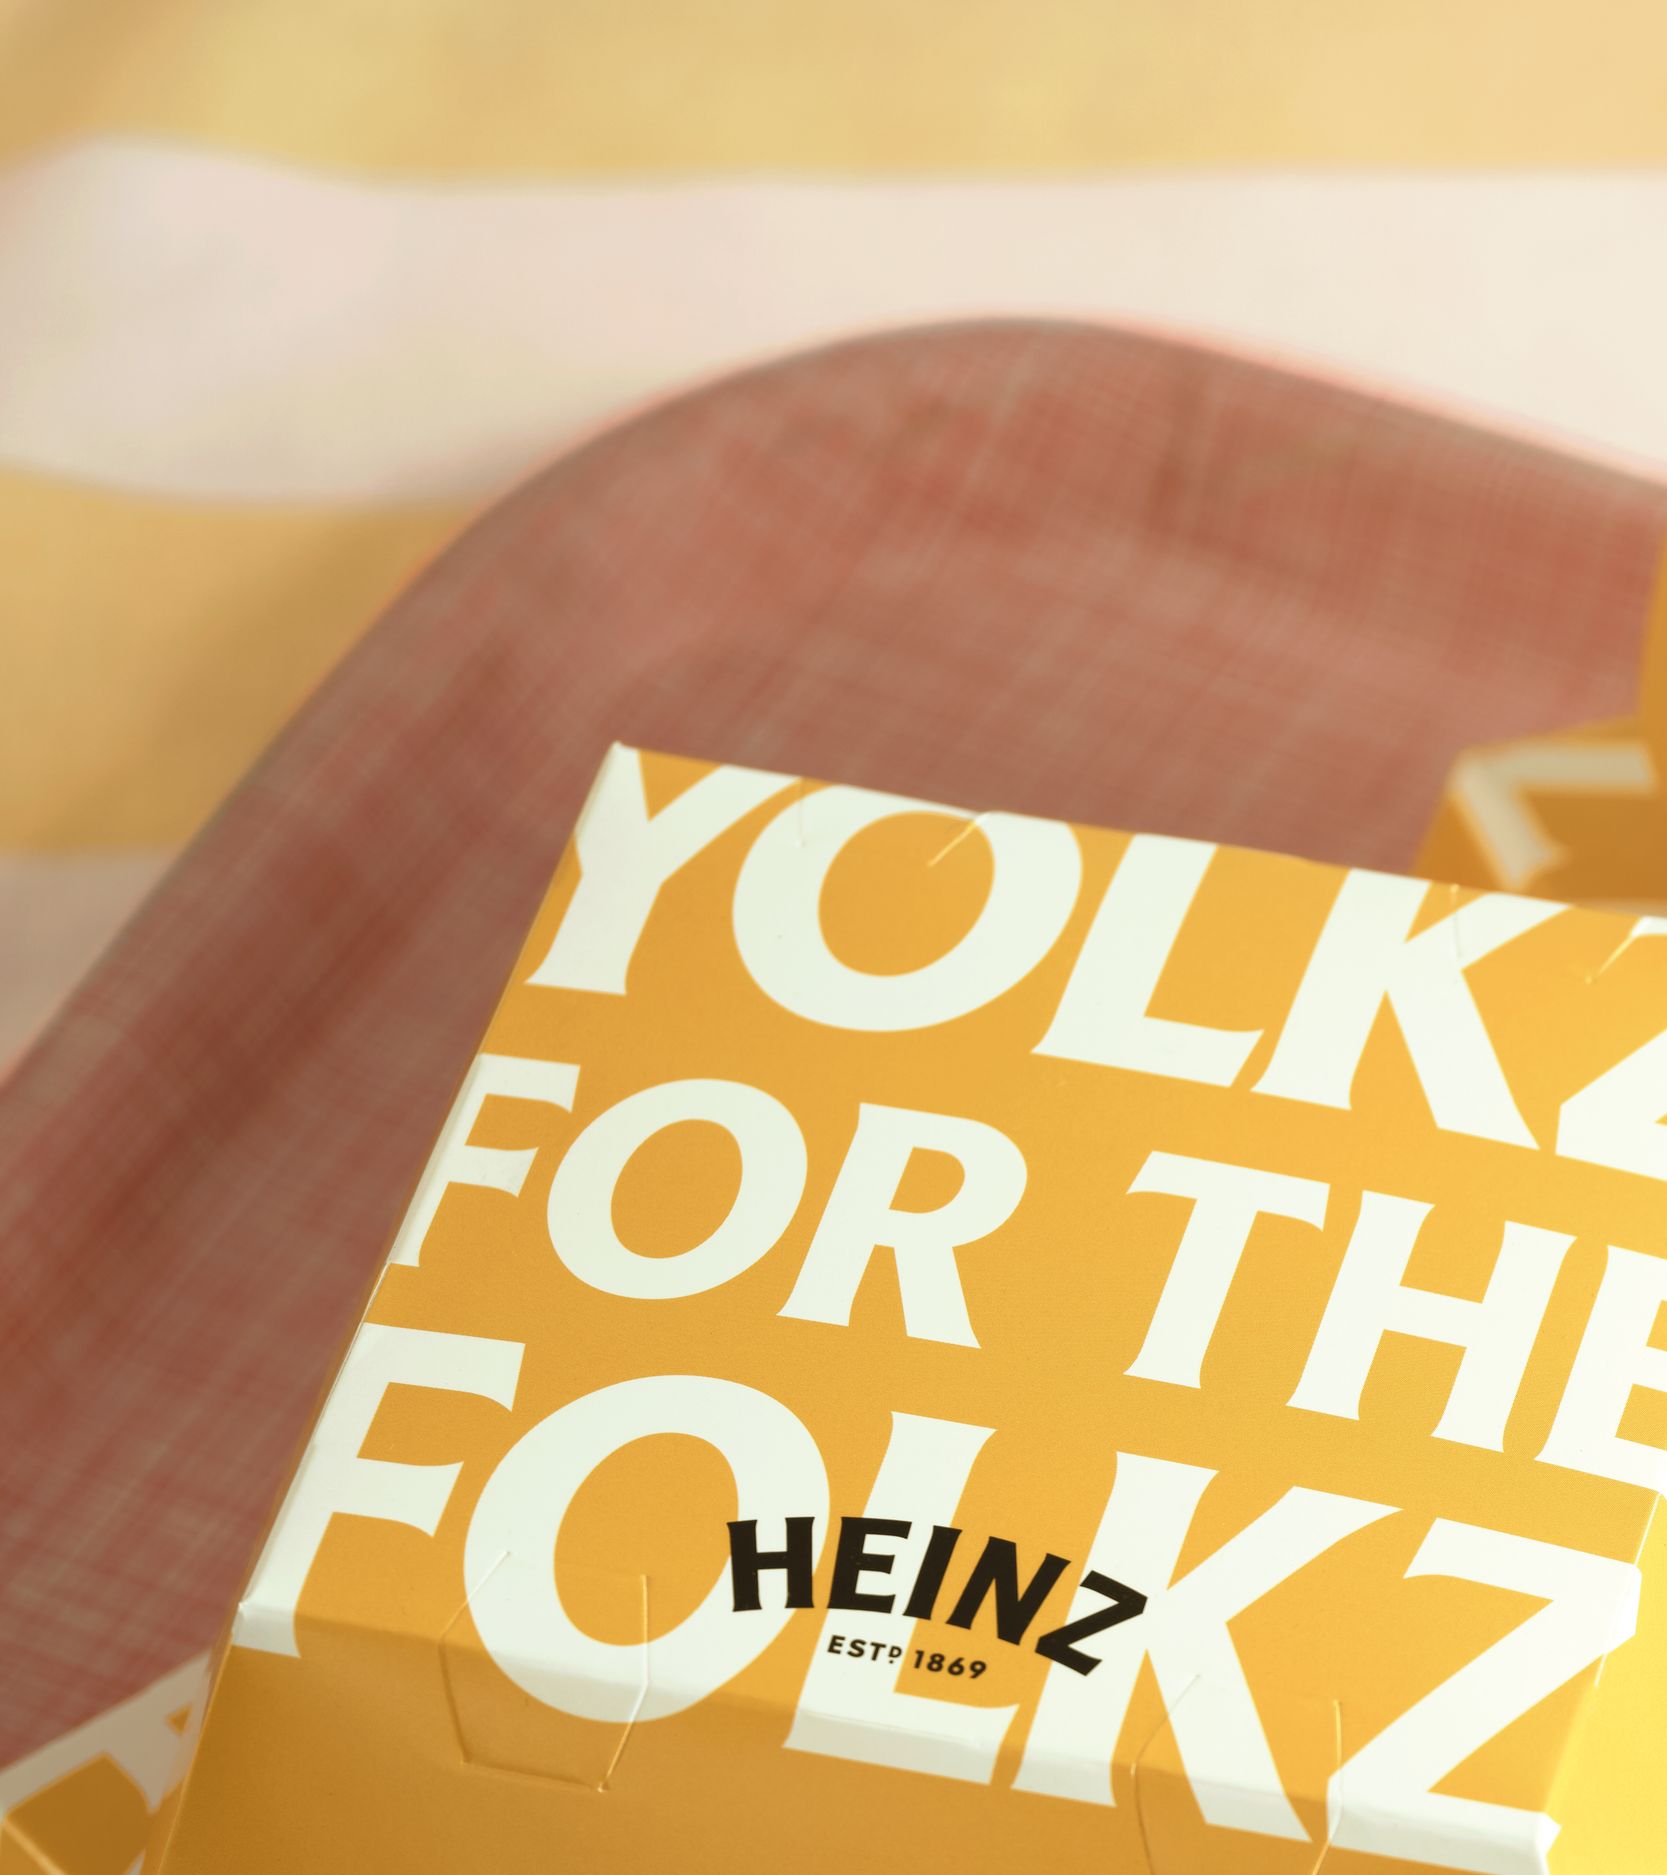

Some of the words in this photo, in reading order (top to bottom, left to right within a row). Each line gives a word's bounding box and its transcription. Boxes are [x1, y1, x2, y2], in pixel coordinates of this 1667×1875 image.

[386, 1052, 1028, 1350] FOR
[727, 1516, 1148, 1677] HEINZ
[912, 1648, 988, 1681] 1869
